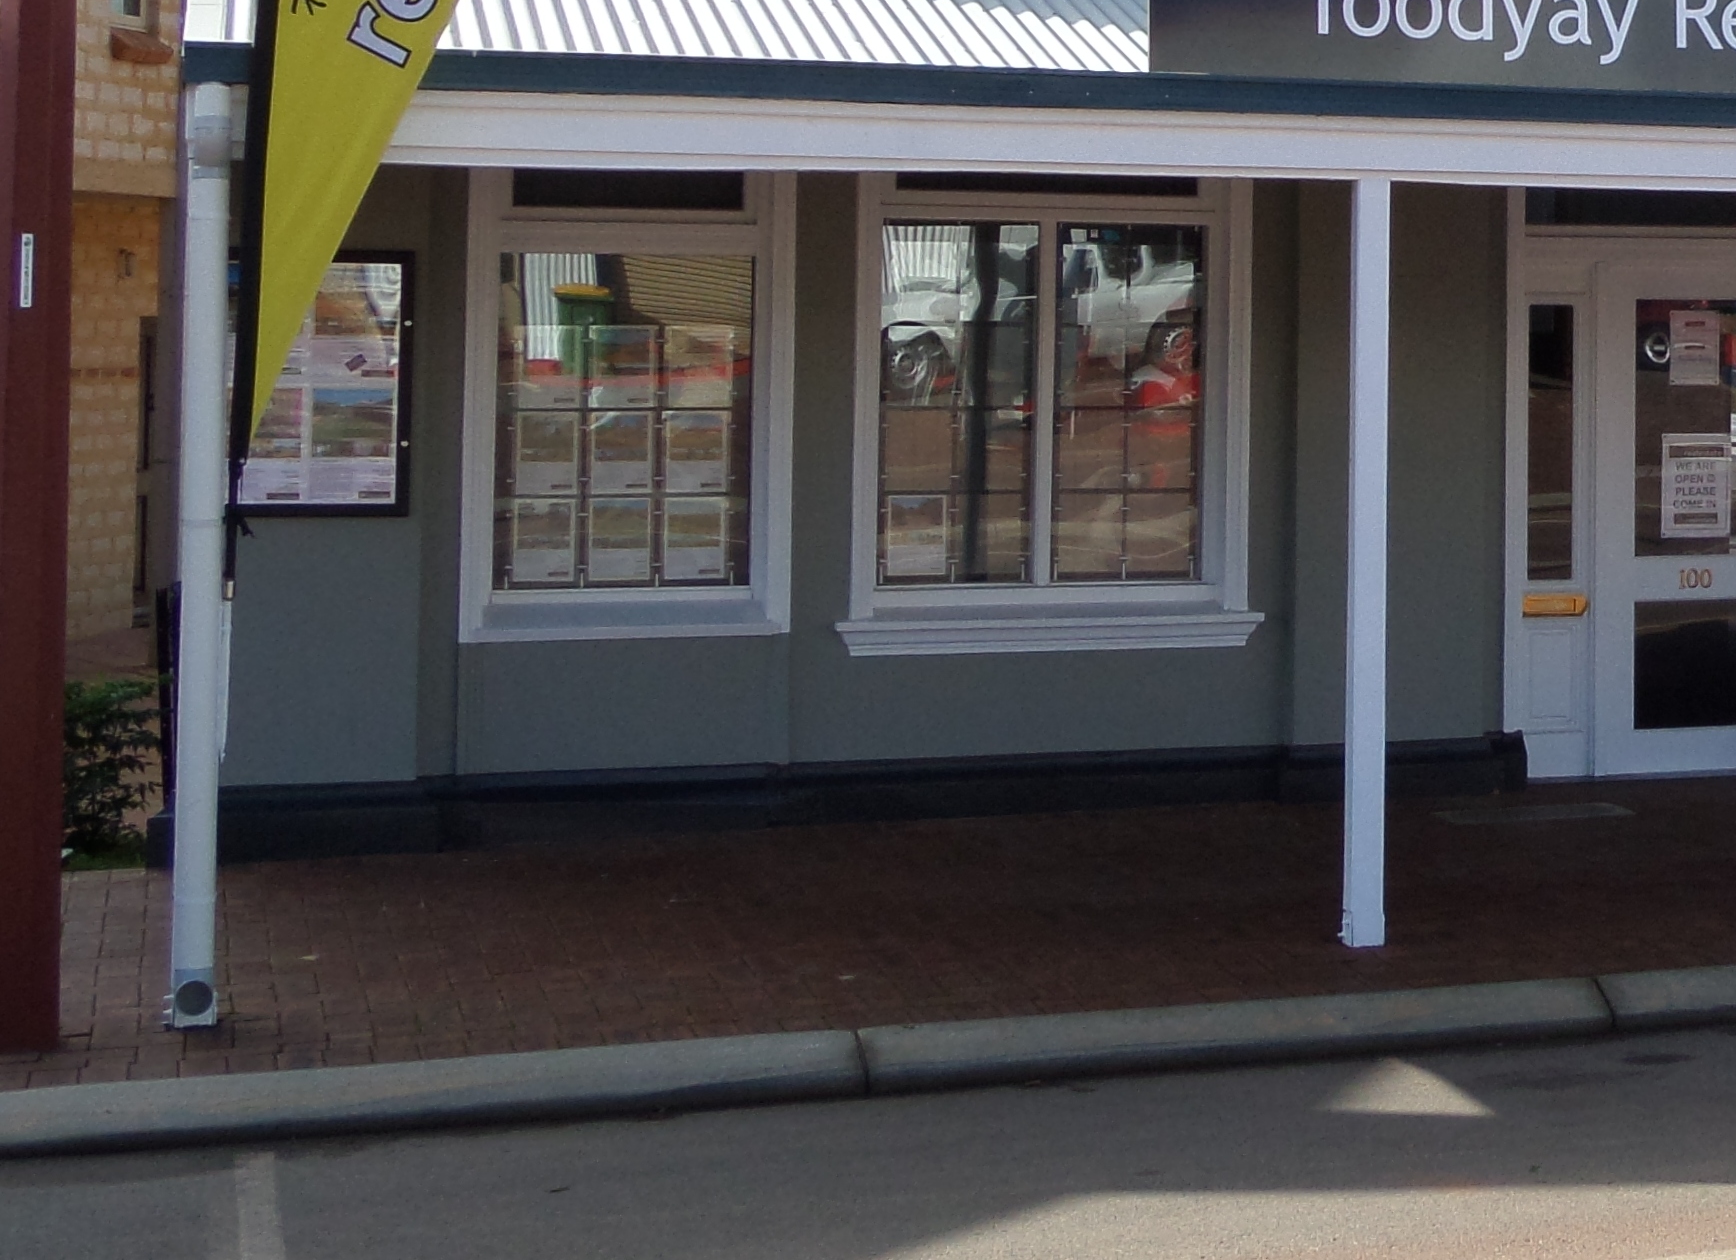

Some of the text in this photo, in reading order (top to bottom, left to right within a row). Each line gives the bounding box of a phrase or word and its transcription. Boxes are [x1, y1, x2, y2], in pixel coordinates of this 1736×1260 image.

[1674, 474, 1704, 483] OPEN
[1675, 486, 1716, 496] PLEASE
[1678, 568, 1713, 590] 100
